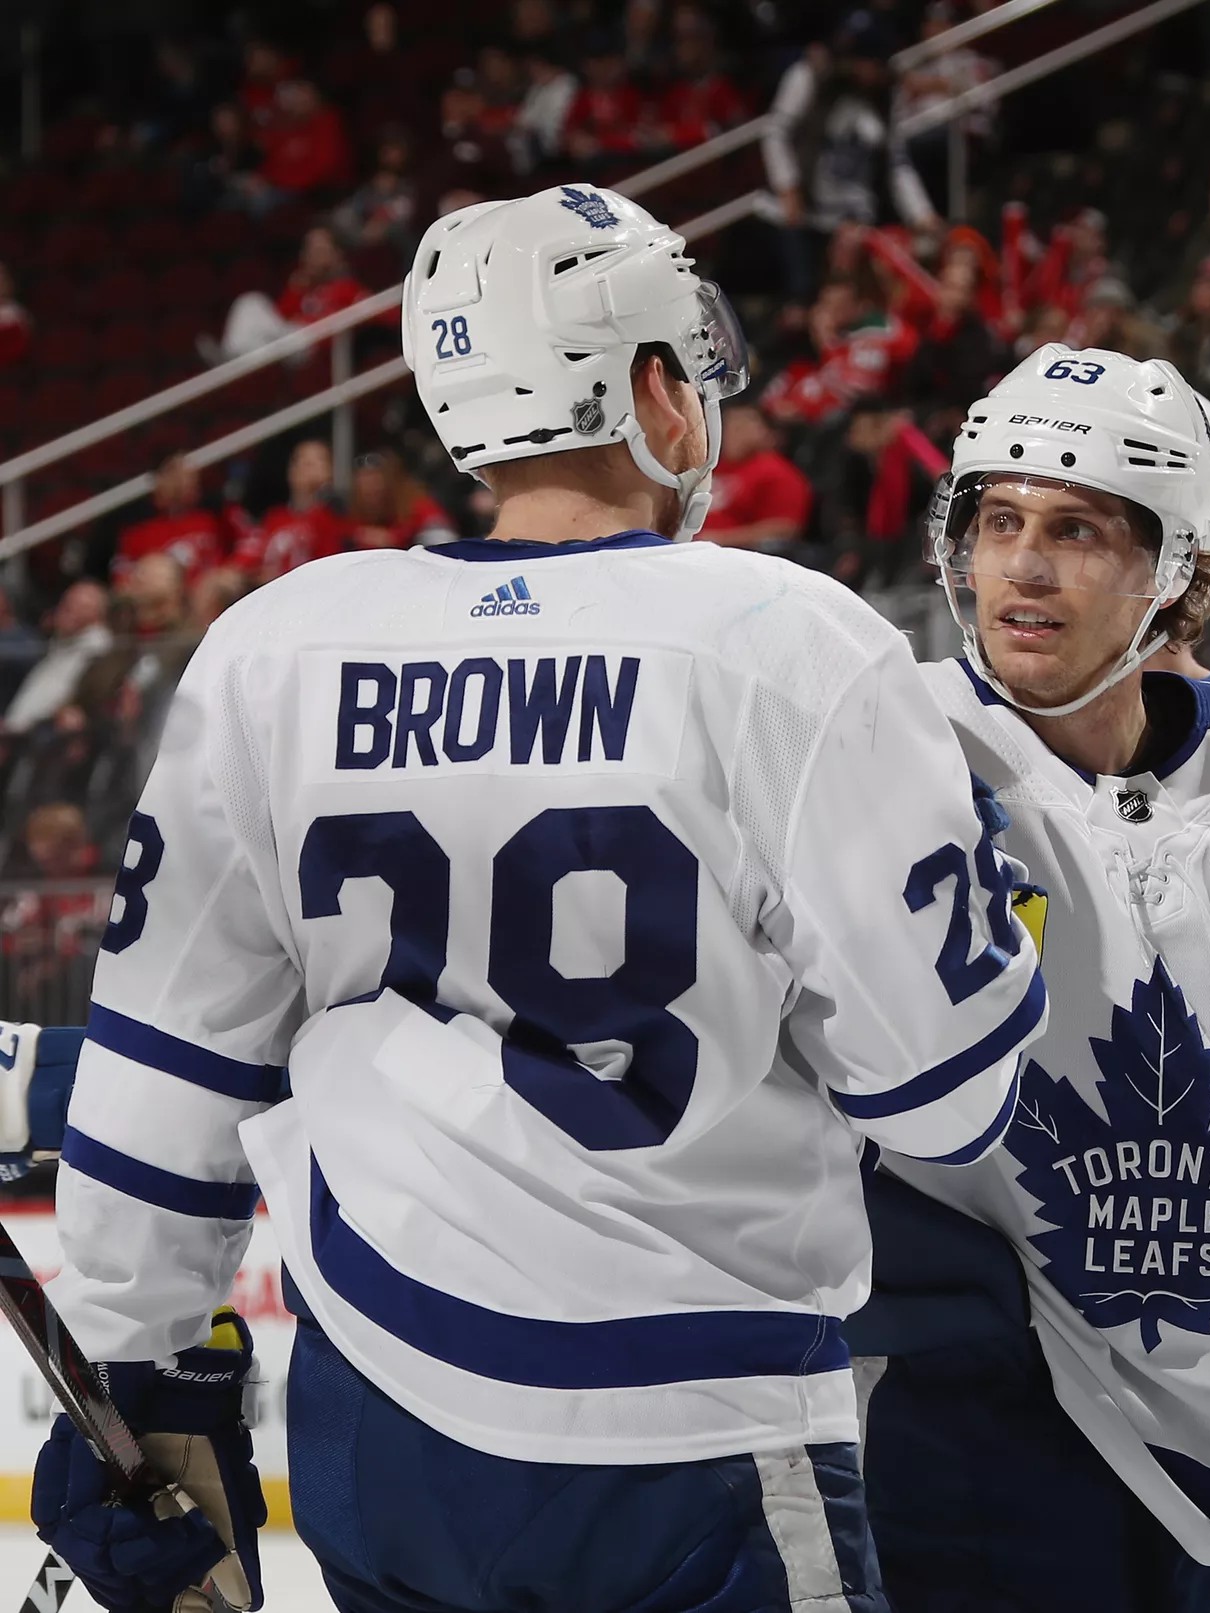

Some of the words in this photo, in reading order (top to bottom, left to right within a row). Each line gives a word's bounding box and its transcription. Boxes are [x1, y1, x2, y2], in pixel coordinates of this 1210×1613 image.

[431, 315, 472, 360] 28
[1044, 360, 1106, 385] 63
[470, 599, 541, 618] adidas
[335, 655, 641, 770] BROWN
[1122, 797, 1144, 816] NHL
[299, 805, 699, 1151] 28
[162, 1368, 234, 1383] BAUER
